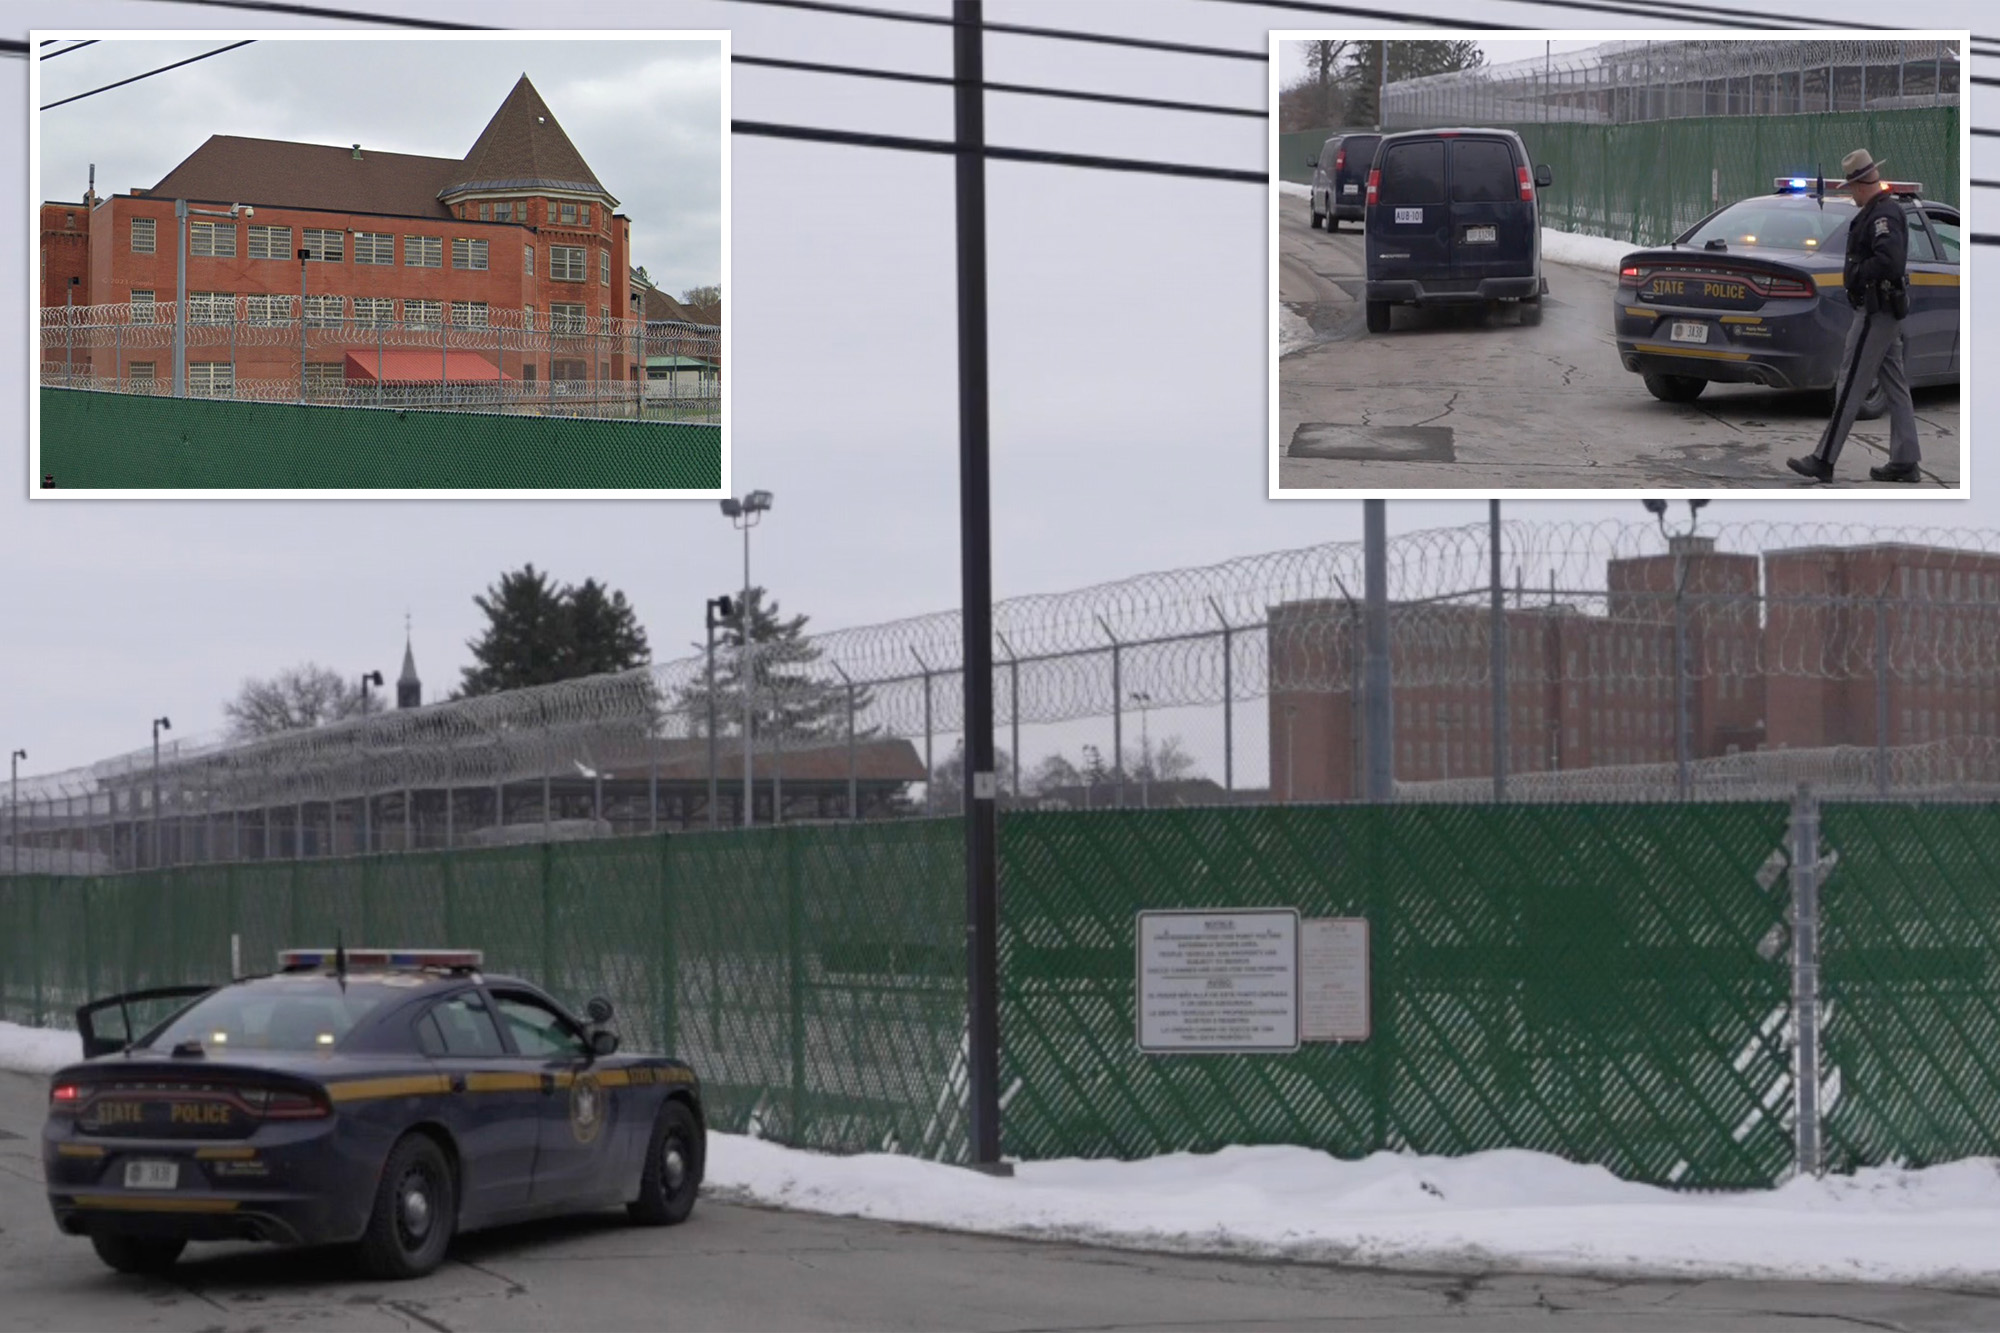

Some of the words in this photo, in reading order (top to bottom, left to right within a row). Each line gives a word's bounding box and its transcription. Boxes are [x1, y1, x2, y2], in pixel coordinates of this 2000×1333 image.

[1653, 280, 1684, 294] STATE
[1704, 283, 1745, 298] POLICE
[98, 1102, 142, 1123] STATE
[172, 1102, 231, 1122] POLICE
